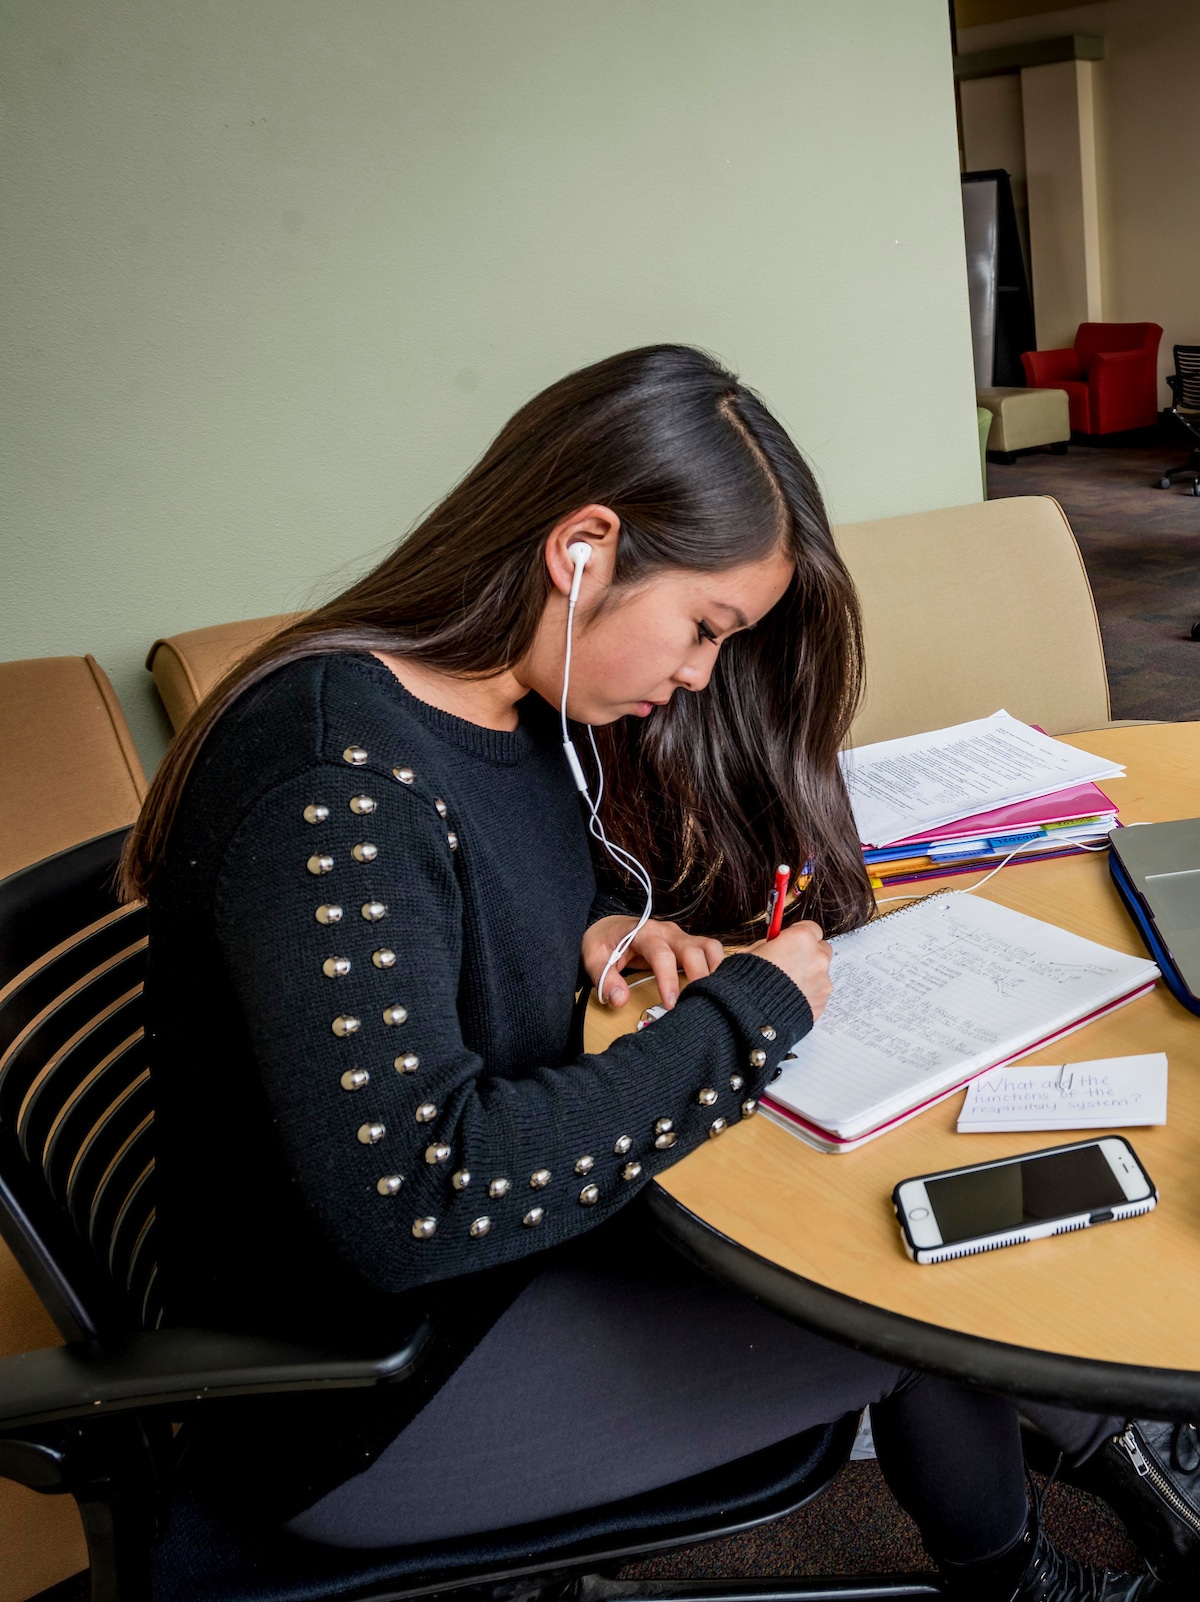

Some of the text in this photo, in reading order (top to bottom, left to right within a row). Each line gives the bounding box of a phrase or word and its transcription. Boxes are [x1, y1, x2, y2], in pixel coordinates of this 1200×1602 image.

[976, 1077, 1034, 1093] What
[1078, 1074, 1111, 1086] the
[972, 1093, 1142, 1114] respiratory system?
[974, 1086, 1115, 1104] functions of the
